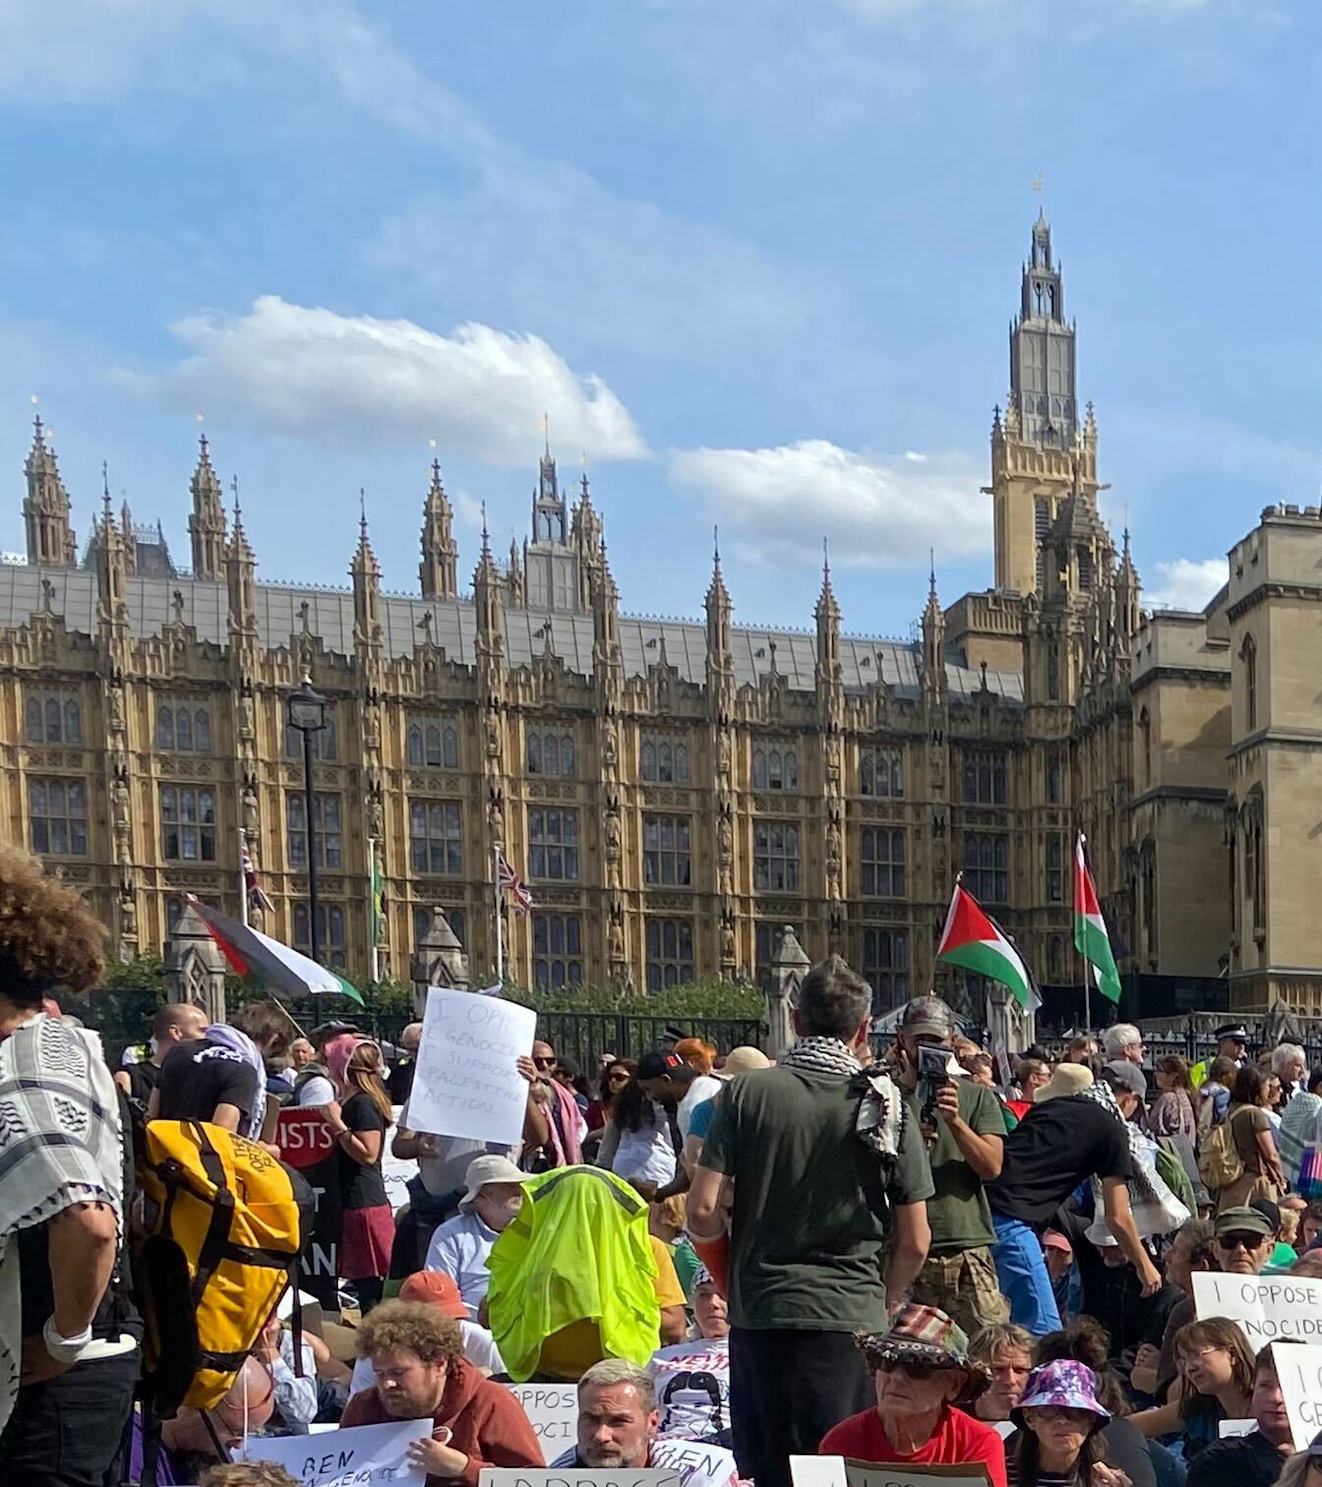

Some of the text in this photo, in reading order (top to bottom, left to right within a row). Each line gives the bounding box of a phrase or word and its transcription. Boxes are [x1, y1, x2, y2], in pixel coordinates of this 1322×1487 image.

[1214, 1281, 1319, 1304] I OPPOSE
[1297, 1365, 1306, 1393] I
